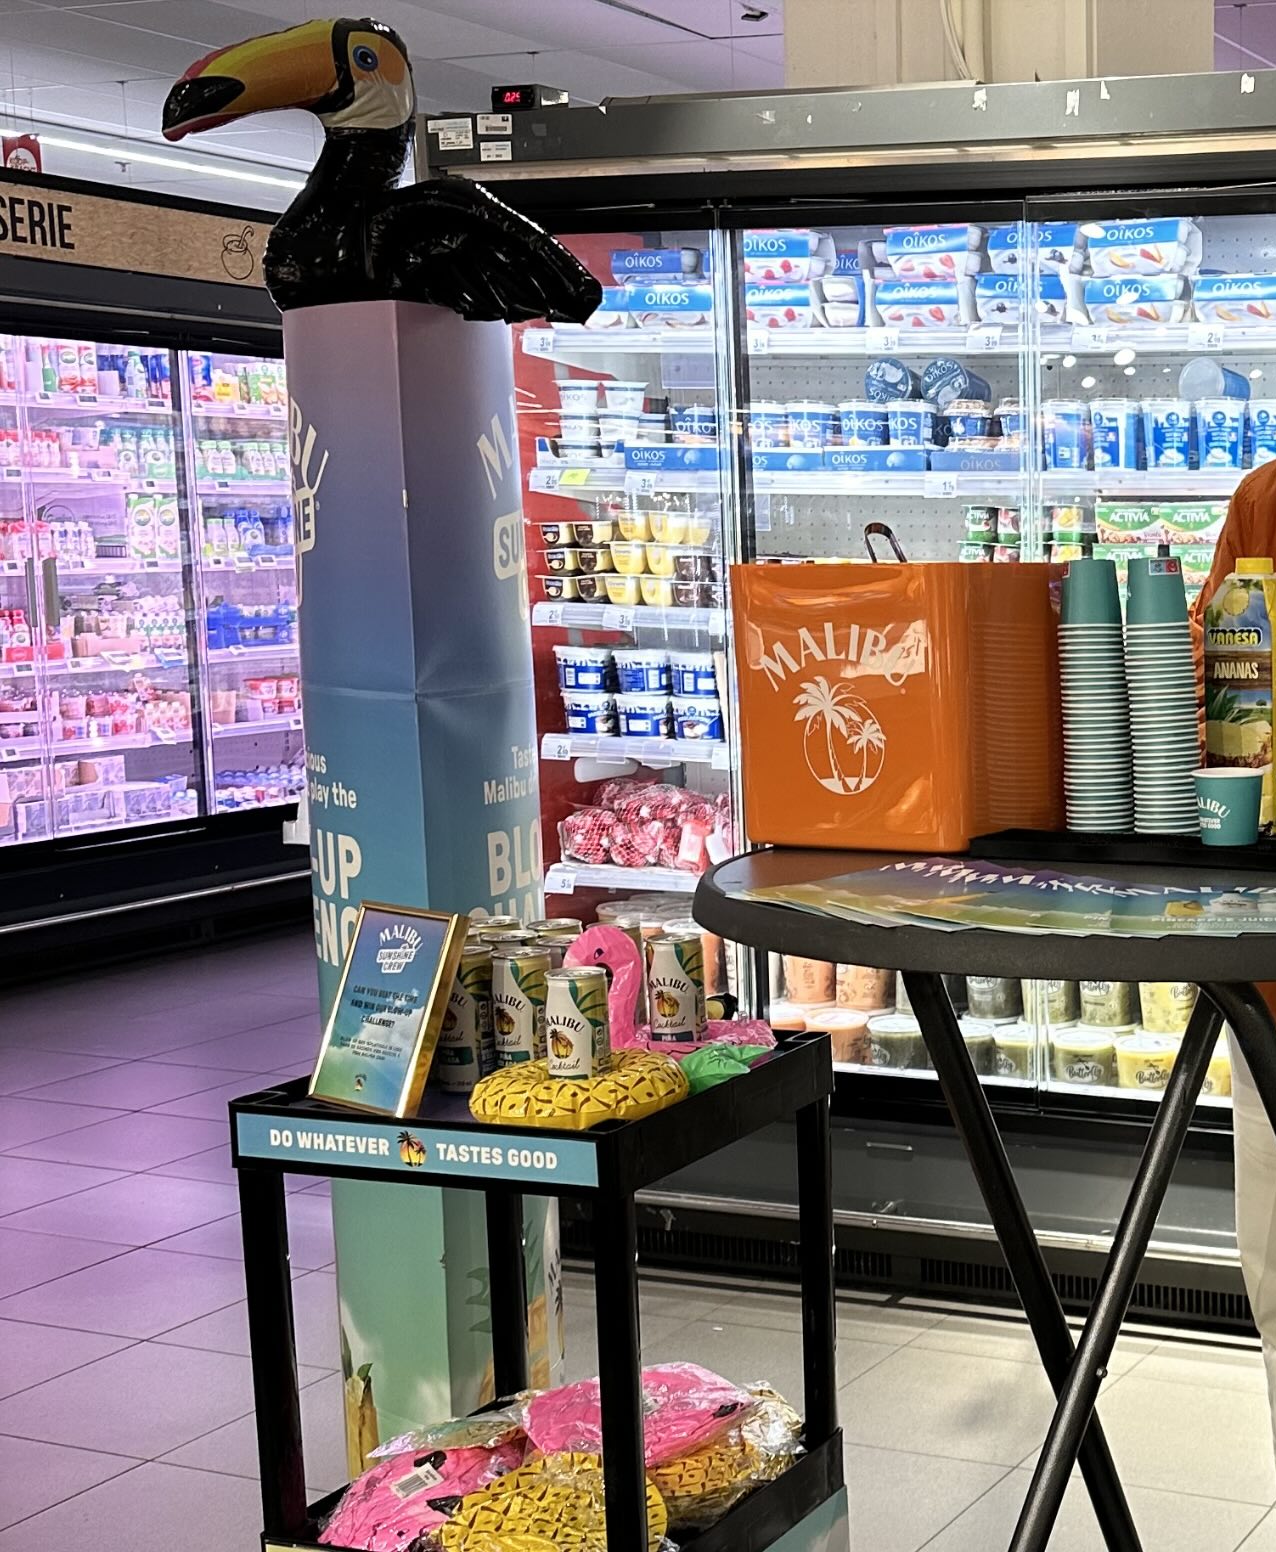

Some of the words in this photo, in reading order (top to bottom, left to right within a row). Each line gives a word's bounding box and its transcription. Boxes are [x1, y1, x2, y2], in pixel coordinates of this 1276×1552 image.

[903, 232, 946, 249] OÎKOS
[625, 252, 663, 269] OÎKOS
[631, 448, 667, 462] OÎKOS
[831, 451, 868, 465] OÎKOS
[1109, 510, 1150, 523] ACTIVIA
[1172, 510, 1210, 523] ACTIVIA
[760, 621, 916, 693] MALIBU
[1213, 661, 1259, 679] ANANAS
[332, 782, 358, 809] the
[483, 777, 527, 806] Malibu
[379, 924, 424, 950] MALIBU
[383, 961, 404, 971] CREW
[269, 1128, 294, 1147] DO
[296, 1130, 390, 1157] WHATEVER
[436, 1142, 504, 1166] TASTES
[507, 1148, 558, 1170] GOOD
